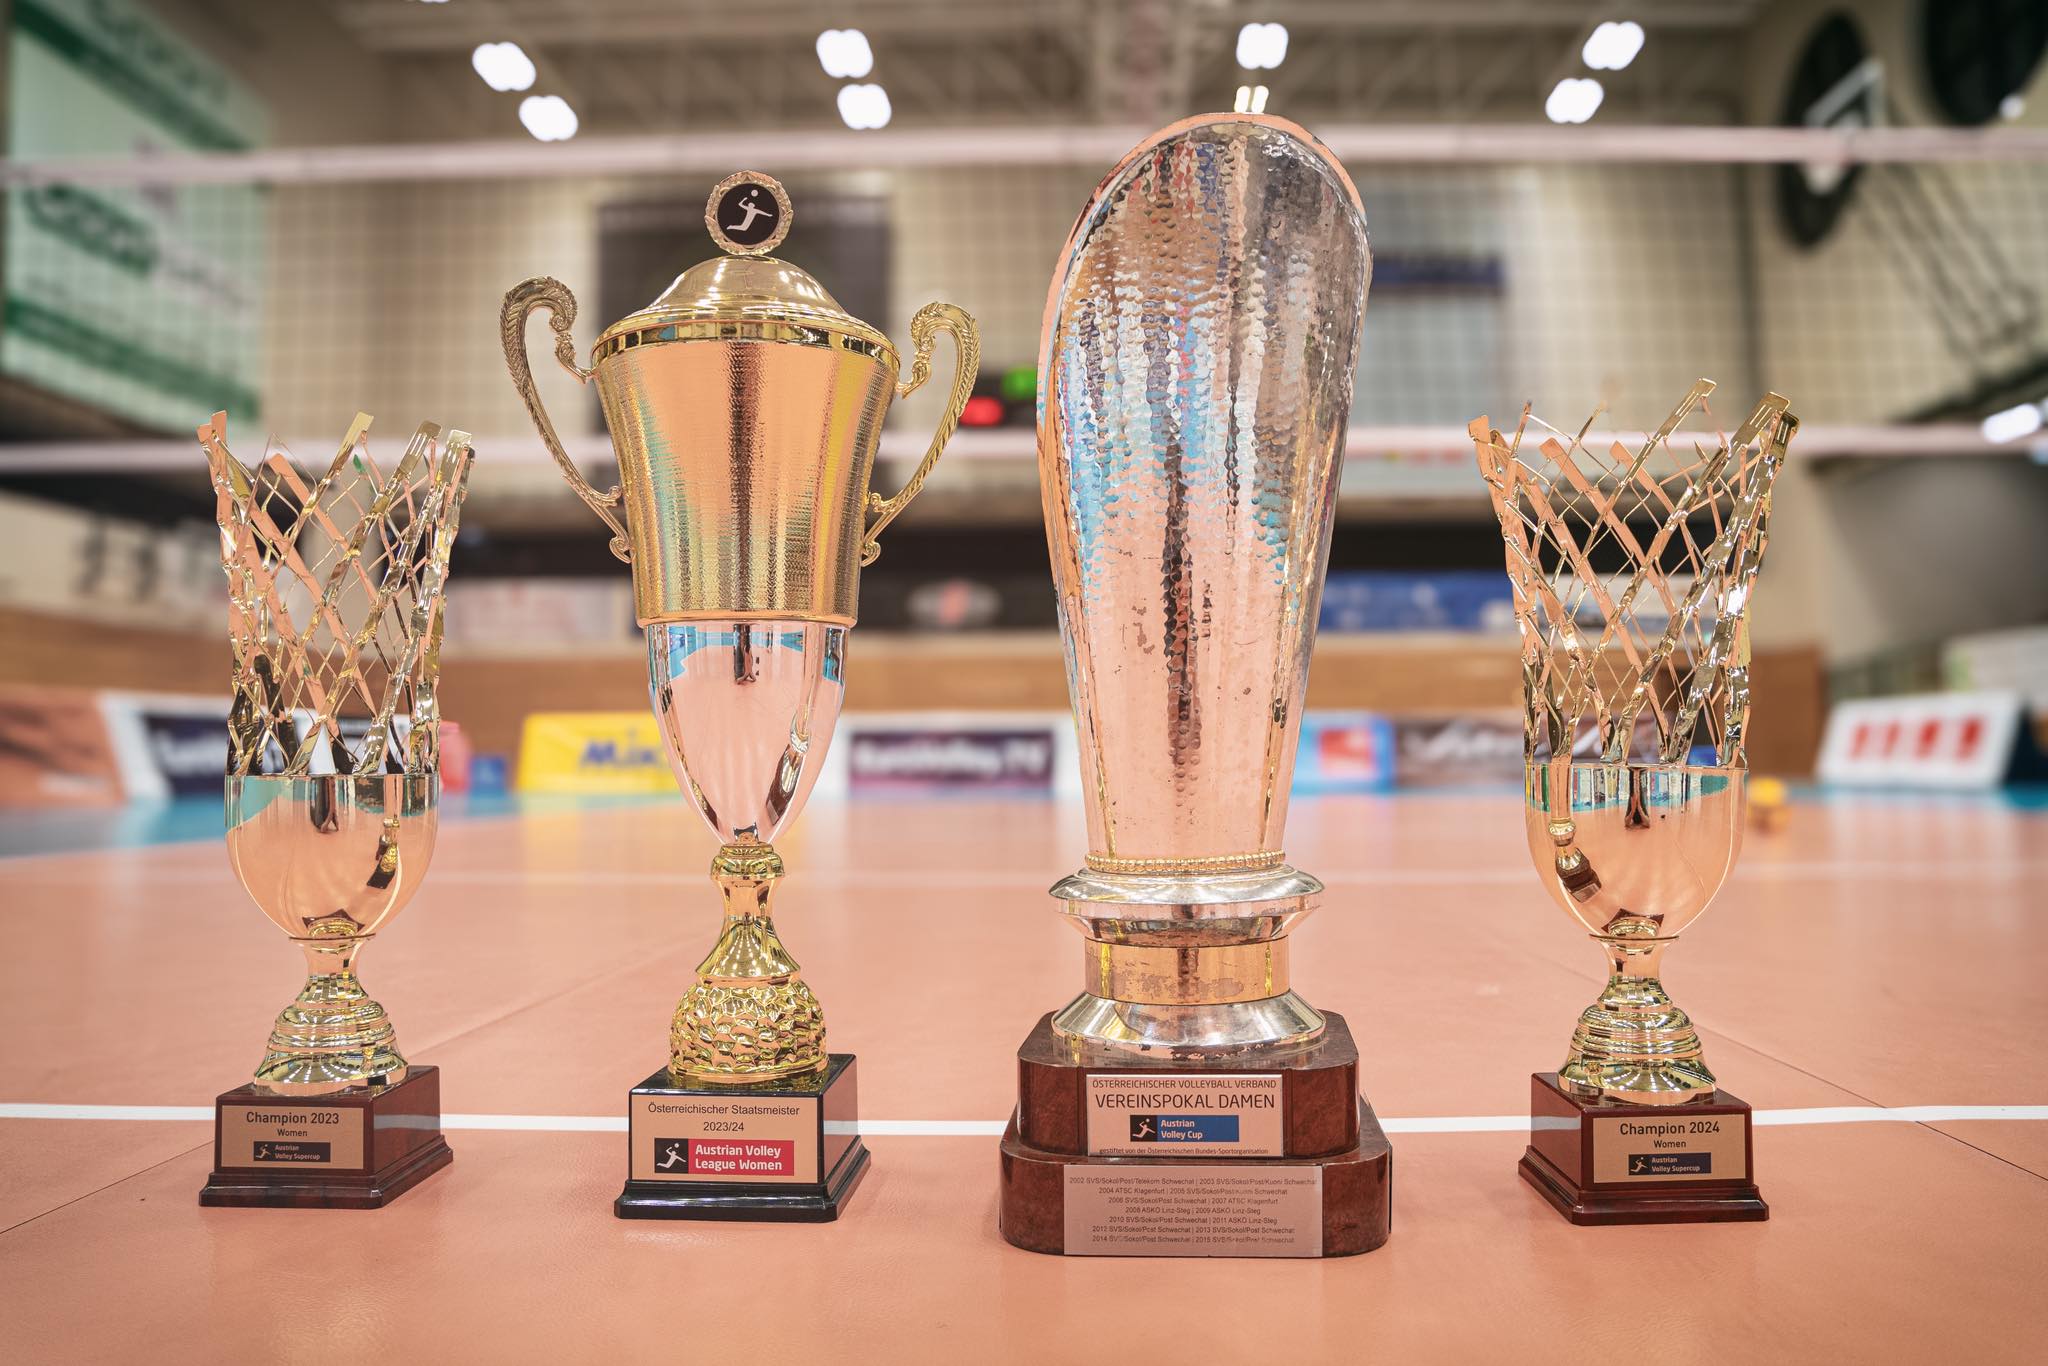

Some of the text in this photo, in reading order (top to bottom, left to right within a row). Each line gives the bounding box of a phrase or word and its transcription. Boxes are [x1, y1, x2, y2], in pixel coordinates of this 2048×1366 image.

[1093, 1079, 1277, 1089] ÖSTERREICHISCHER VOLLEYBALL VERBAND
[1096, 1094, 1275, 1109] VEREINSPOKAL DAMEN
[648, 1102, 800, 1115] Österreichischer Staatsmeister
[247, 1112, 339, 1126] Champion 2023
[703, 1122, 744, 1132] 2023/24
[1620, 1121, 1720, 1136] Champion 2024
[277, 1129, 307, 1137] Women
[1161, 1131, 1203, 1139] Volley Cup
[1654, 1140, 1686, 1148] Women
[696, 1144, 781, 1158] Austrian Volley
[695, 1159, 782, 1171] League Women
[1652, 1165, 1671, 1173] Volley
[1174, 1216, 1208, 1224] Schwechat
